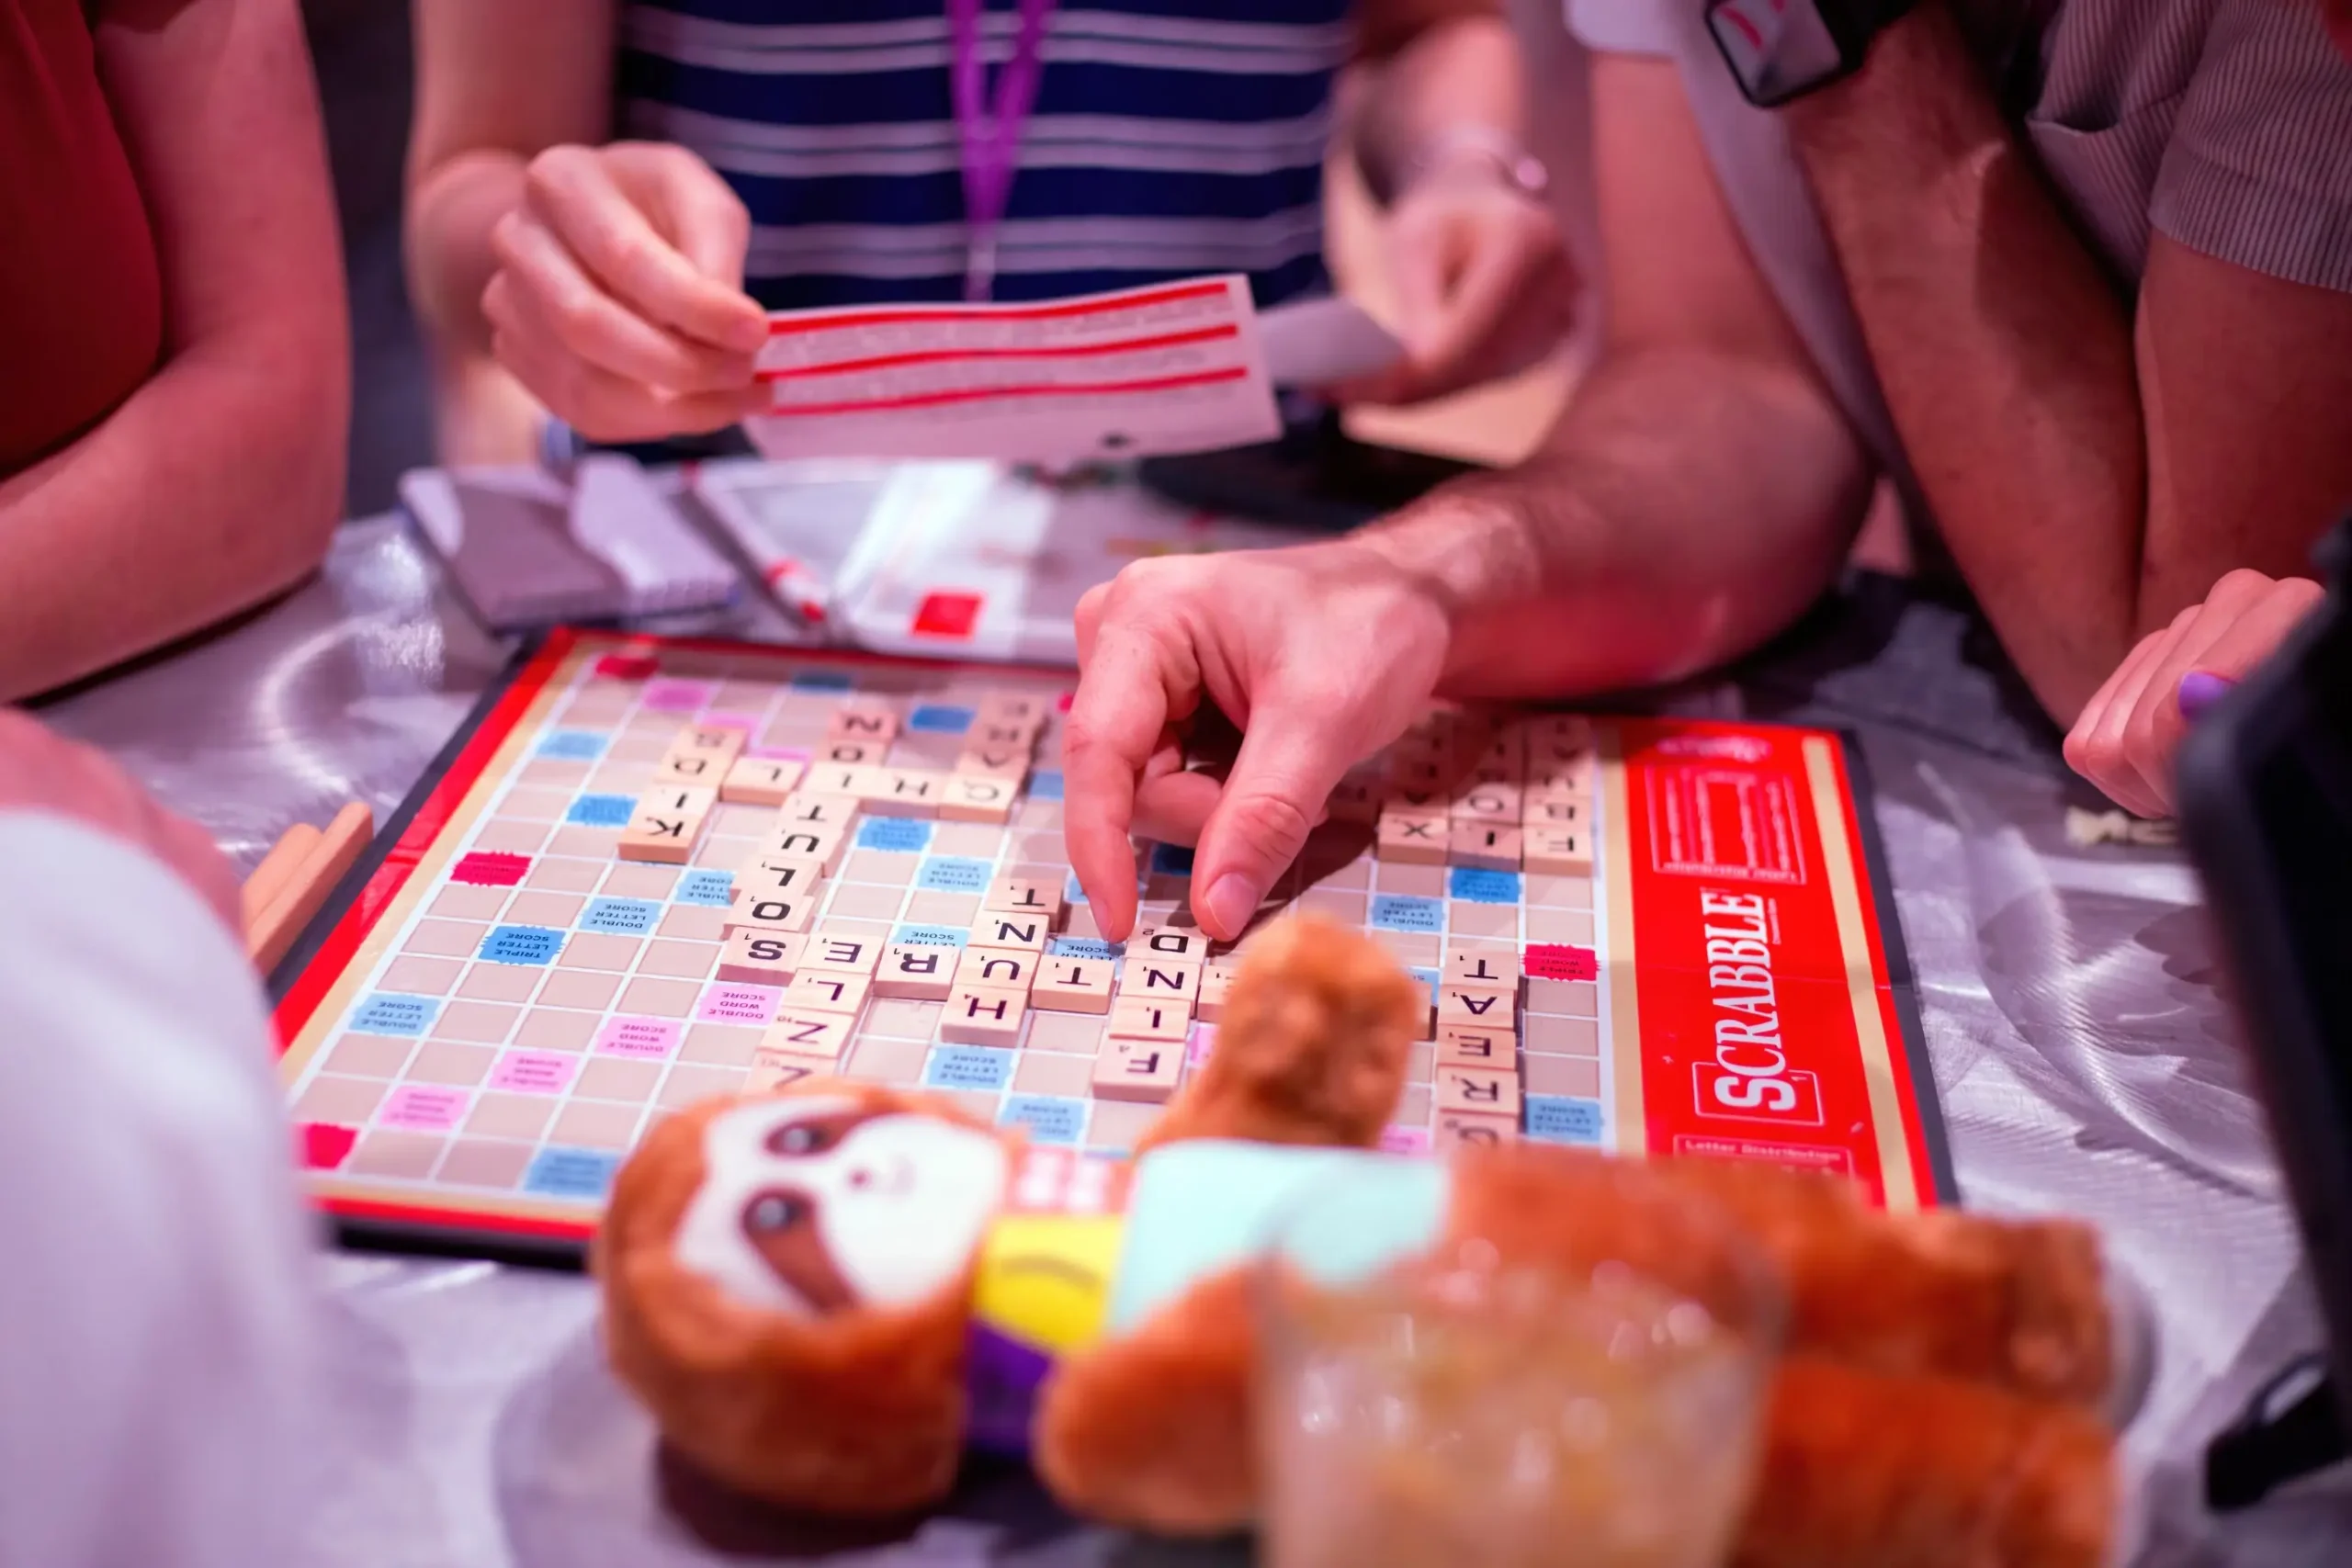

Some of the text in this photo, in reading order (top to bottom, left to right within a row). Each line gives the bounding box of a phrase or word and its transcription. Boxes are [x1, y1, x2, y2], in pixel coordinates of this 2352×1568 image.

[698, 875, 733, 885] CORE
[605, 903, 648, 912] SCORE
[594, 910, 647, 920] LETTER
[589, 919, 643, 929] DOUBLE
[506, 932, 549, 942] SCORE
[911, 931, 955, 941] SCORE
[497, 941, 549, 951] LETTER
[1067, 944, 1111, 953] SCORE
[493, 948, 541, 959] TRIPLE
[721, 991, 766, 1001] SCORE
[1700, 891, 1797, 1111] SCRABBLE
[719, 1000, 760, 1010] WORD
[707, 1008, 764, 1020] DOUBLE
